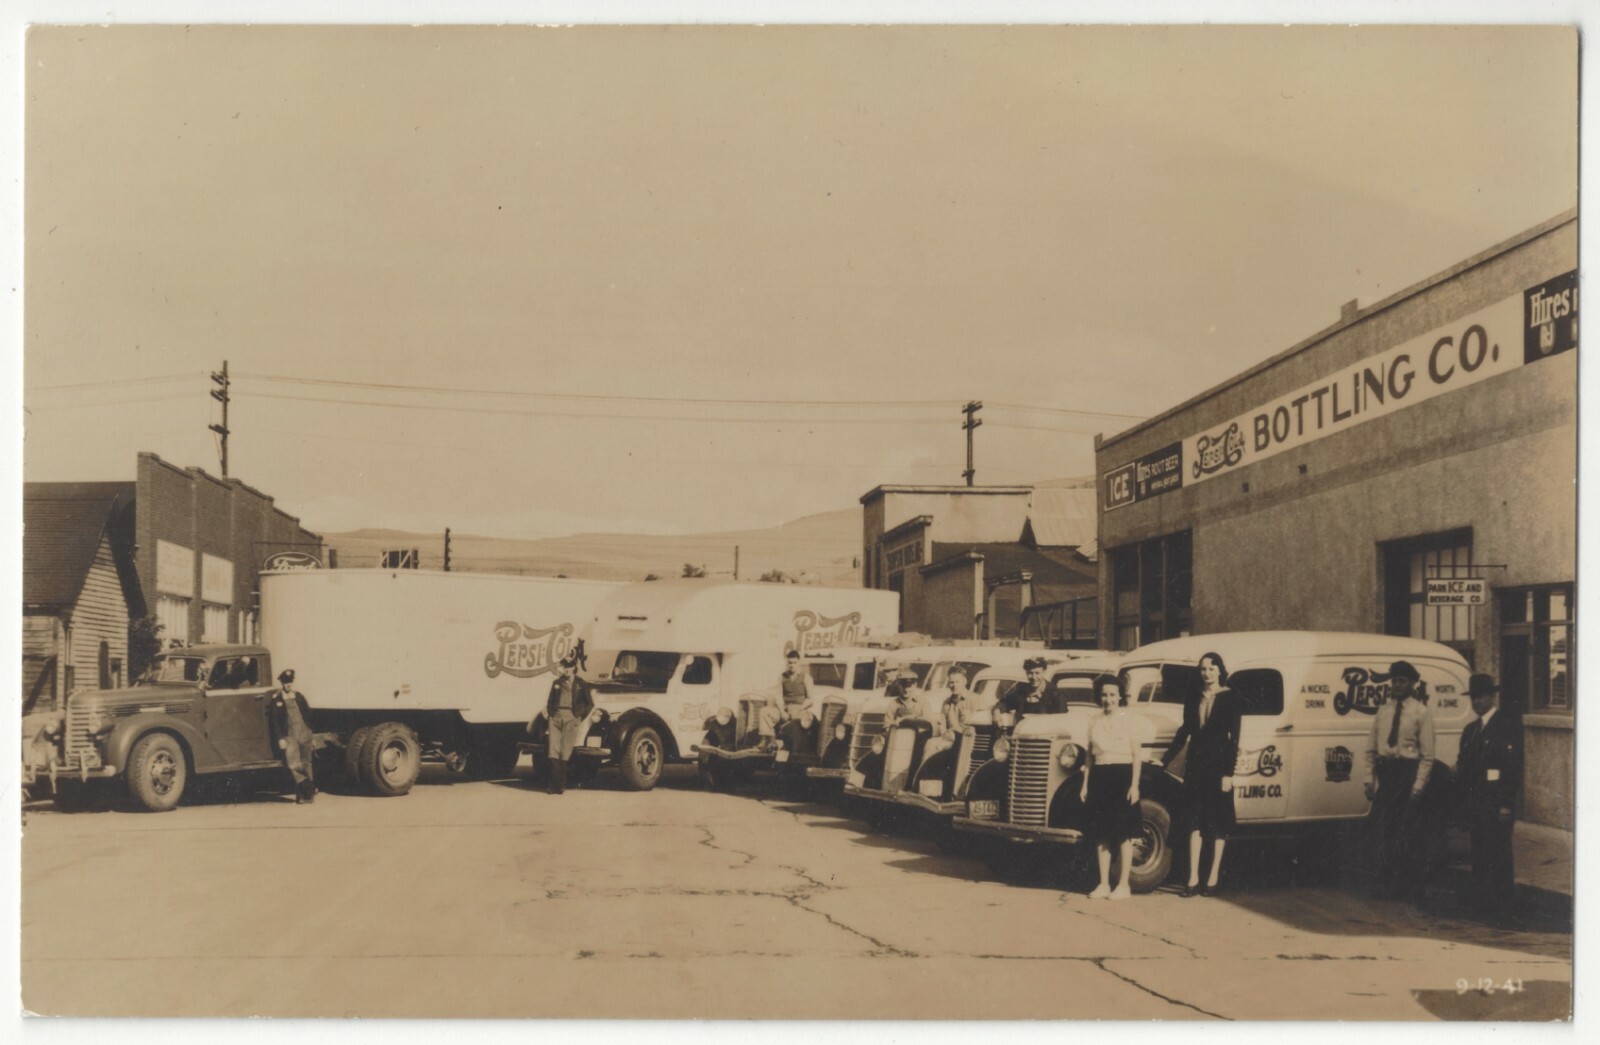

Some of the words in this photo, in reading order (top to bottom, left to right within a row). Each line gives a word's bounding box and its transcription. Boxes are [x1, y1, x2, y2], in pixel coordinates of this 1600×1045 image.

[1530, 287, 1570, 328] Hires
[1254, 354, 1416, 452] BOTTLING
[1428, 324, 1499, 384] CO.
[1110, 473, 1129, 502] ICE
[1428, 583, 1446, 593] PARK
[1448, 581, 1464, 593] ICE
[1466, 583, 1482, 593] AND
[1429, 595, 1464, 603] BEVERAGE
[1300, 685, 1306, 693] A
[1307, 684, 1331, 694] NICKEL
[1435, 684, 1455, 694] WORTH
[1305, 699, 1325, 709] DRINK
[1236, 785, 1266, 798] TLING
